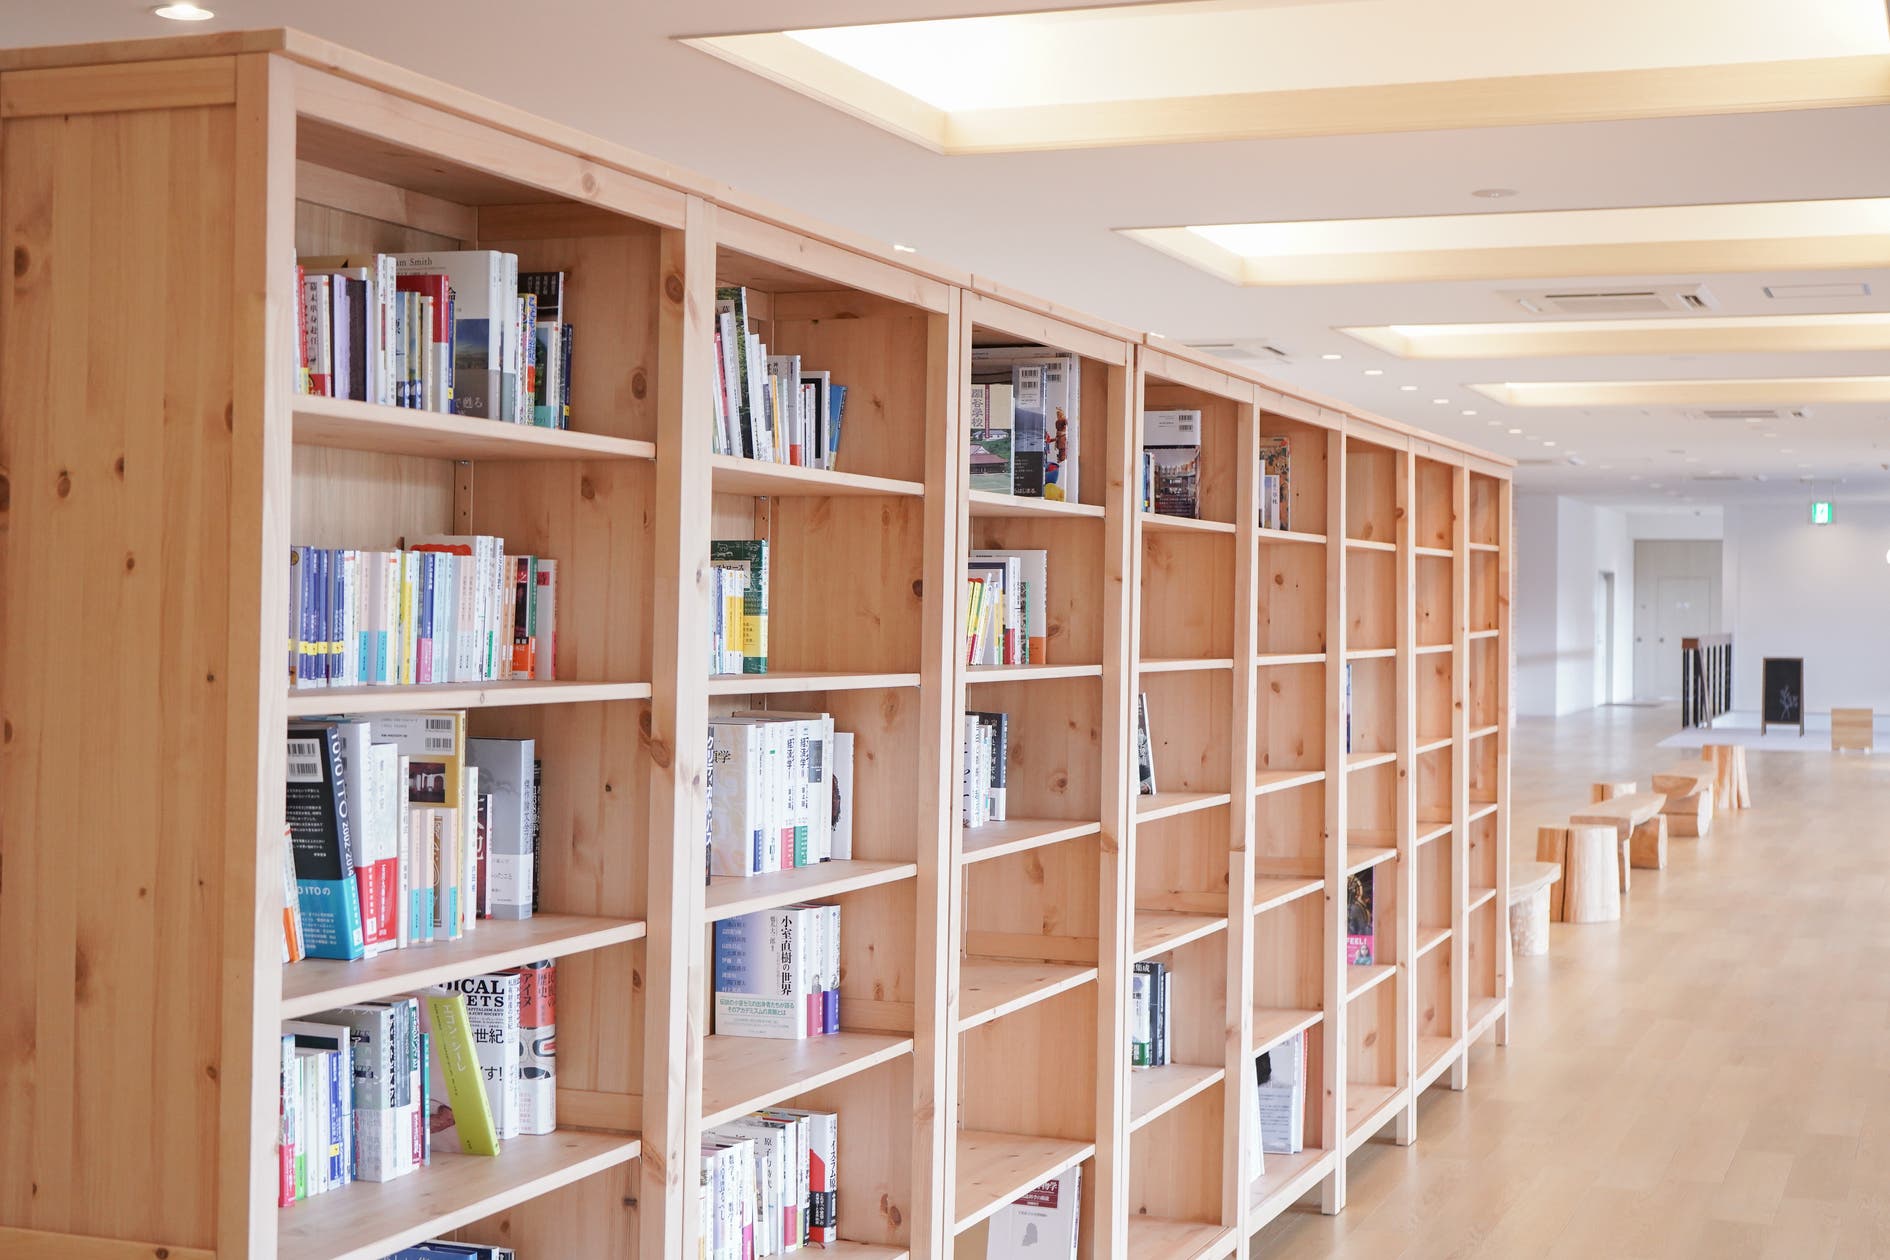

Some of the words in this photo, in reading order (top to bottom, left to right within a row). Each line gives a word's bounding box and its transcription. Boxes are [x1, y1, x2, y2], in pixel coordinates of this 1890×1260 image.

[410, 256, 433, 267] Smith
[330, 727, 344, 777] TOYO
[336, 781, 349, 819] ITO
[780, 914, 793, 997] 小室直樹の世界
[472, 1028, 505, 1045] 世紀
